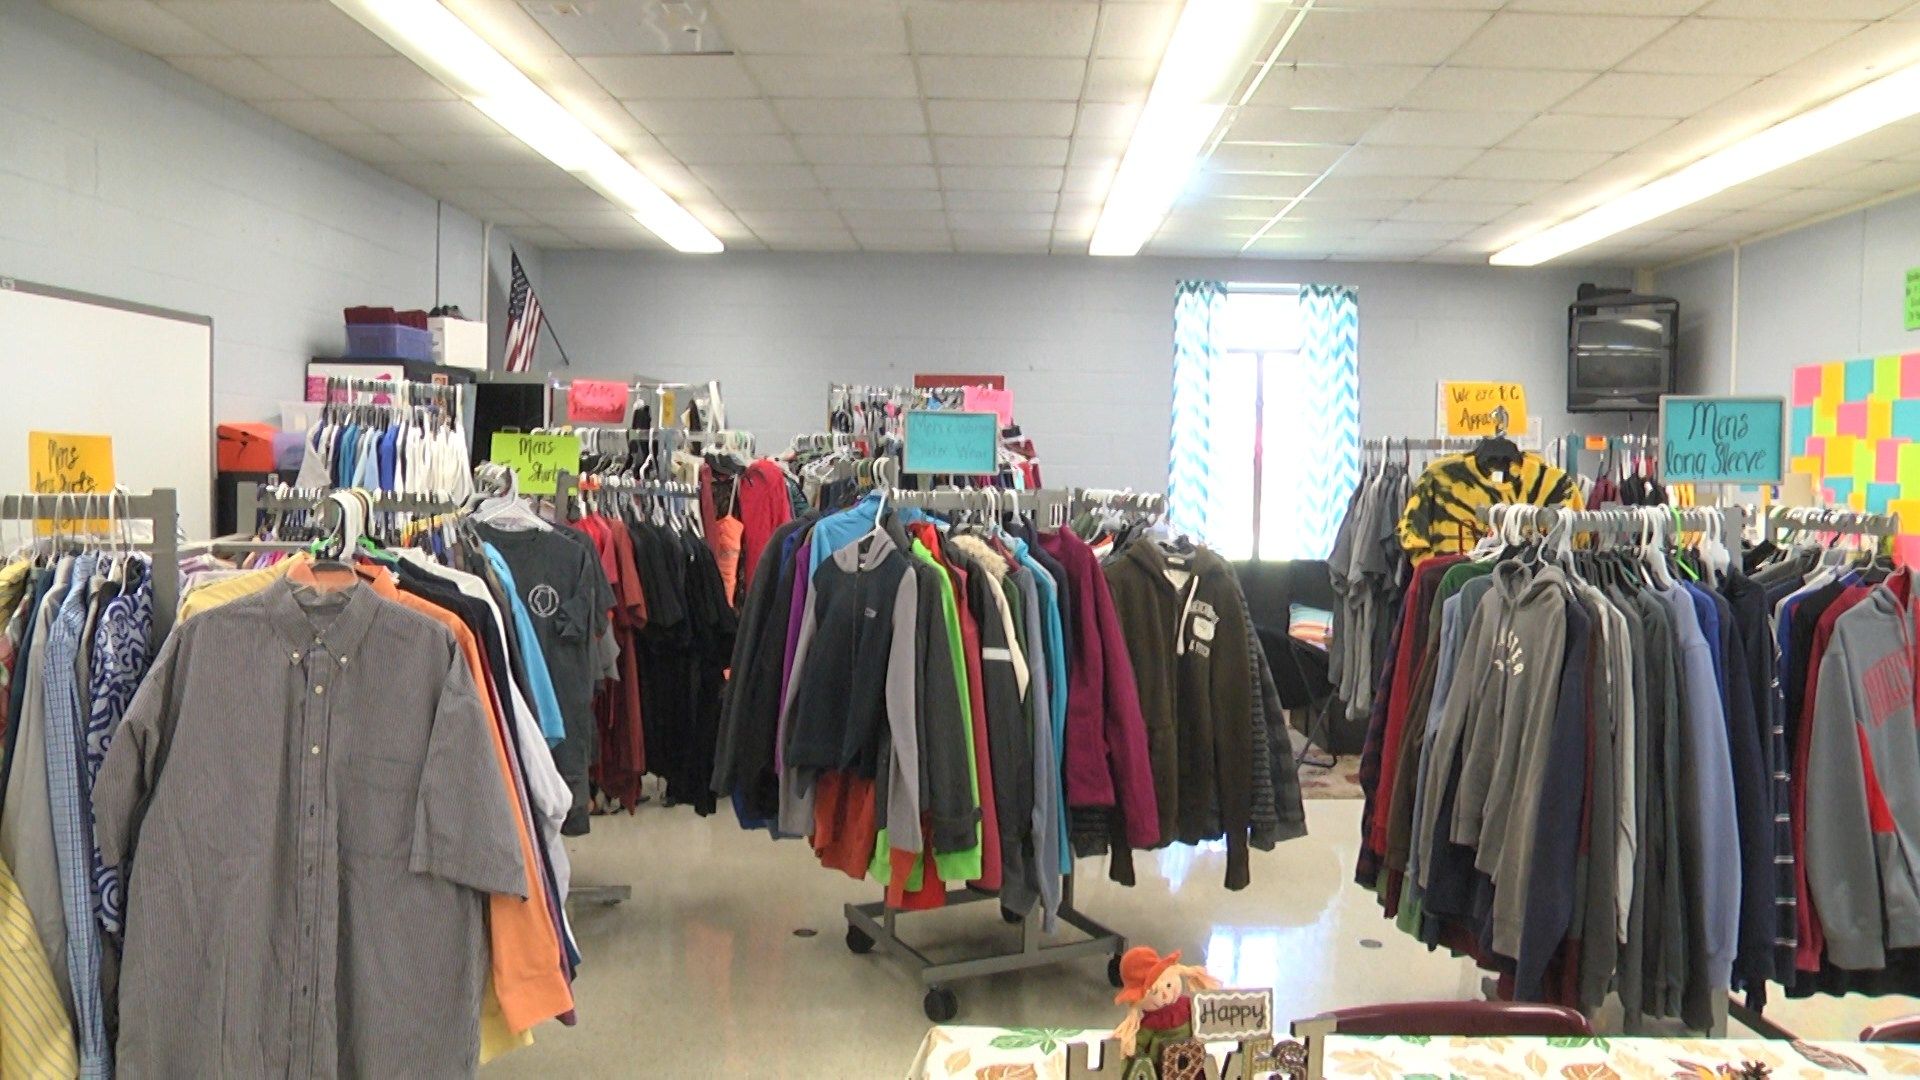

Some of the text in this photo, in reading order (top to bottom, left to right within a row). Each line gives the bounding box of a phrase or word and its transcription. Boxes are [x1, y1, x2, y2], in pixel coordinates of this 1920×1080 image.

[1688, 401, 1749, 447] Mens
[519, 437, 557, 463] Mens
[1199, 1002, 1266, 1028] Happy
